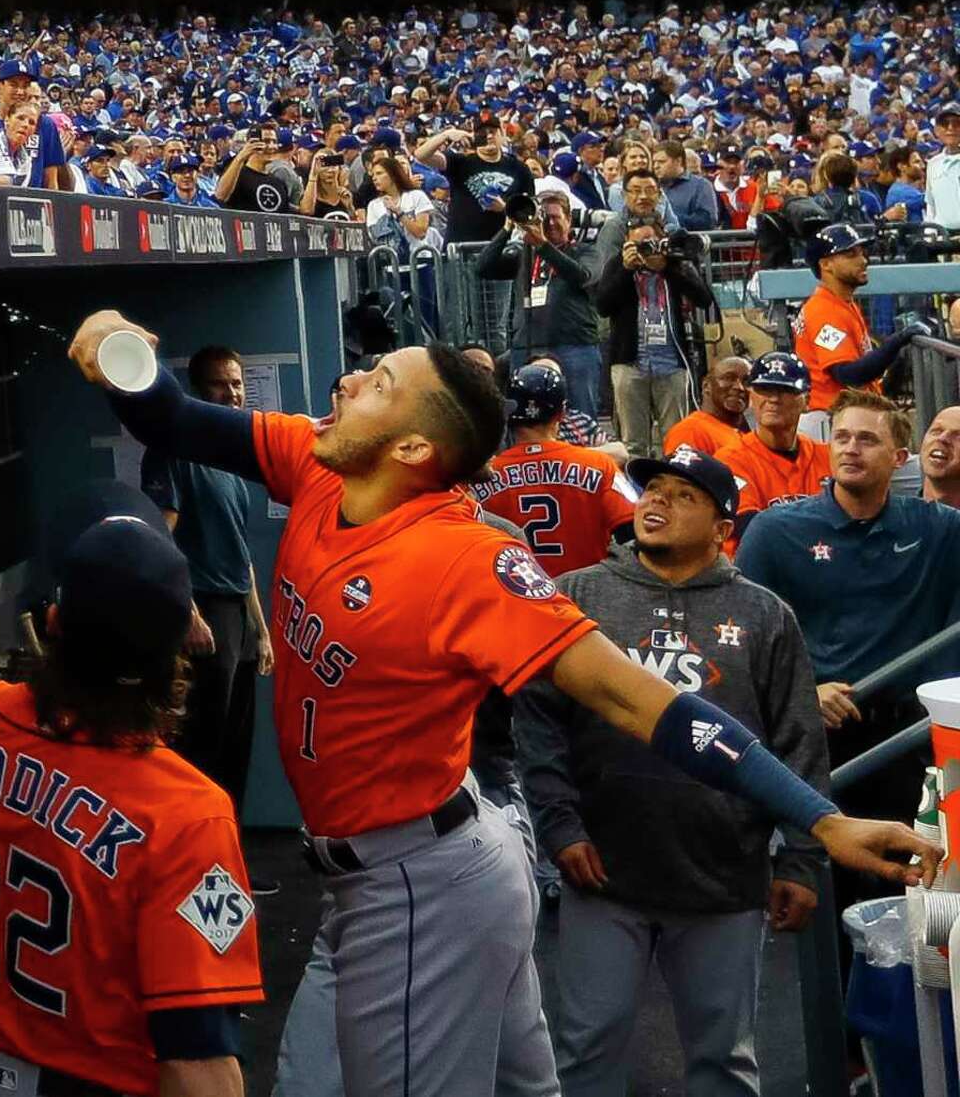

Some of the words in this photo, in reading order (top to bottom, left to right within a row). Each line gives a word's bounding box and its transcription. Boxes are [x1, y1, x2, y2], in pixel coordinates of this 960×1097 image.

[821, 328, 840, 344] WS
[472, 461, 603, 503] BREGMAN
[519, 494, 565, 557] 2
[718, 623, 741, 647] H
[627, 647, 704, 694] WS
[299, 696, 318, 763] 1
[695, 722, 724, 753] adidas
[191, 892, 244, 927] WS
